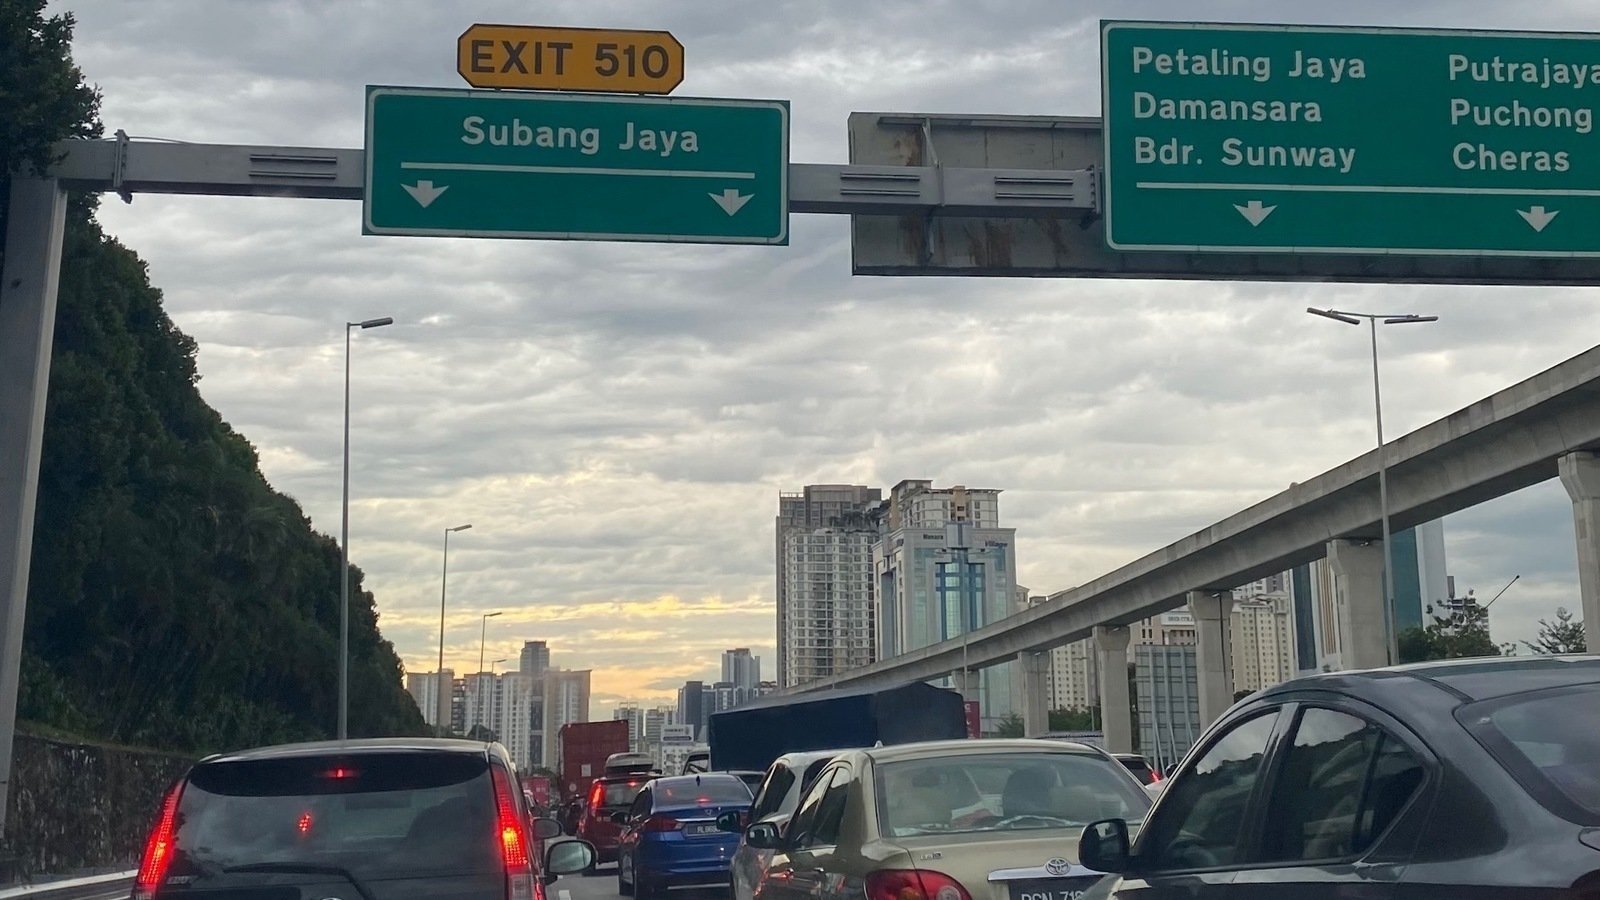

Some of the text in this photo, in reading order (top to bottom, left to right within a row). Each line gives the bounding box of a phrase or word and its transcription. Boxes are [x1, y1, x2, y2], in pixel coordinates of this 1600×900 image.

[470, 40, 669, 79] EXIT 510
[1134, 46, 1366, 84] Petaling Jaya
[1449, 54, 1600, 89] Putrajaya
[1134, 91, 1322, 123] Damansara
[1450, 98, 1593, 134] Puchong
[461, 115, 699, 157] Subang Jaya
[1135, 136, 1356, 174] Bdr. Sunway
[1452, 142, 1570, 172] Cheras
